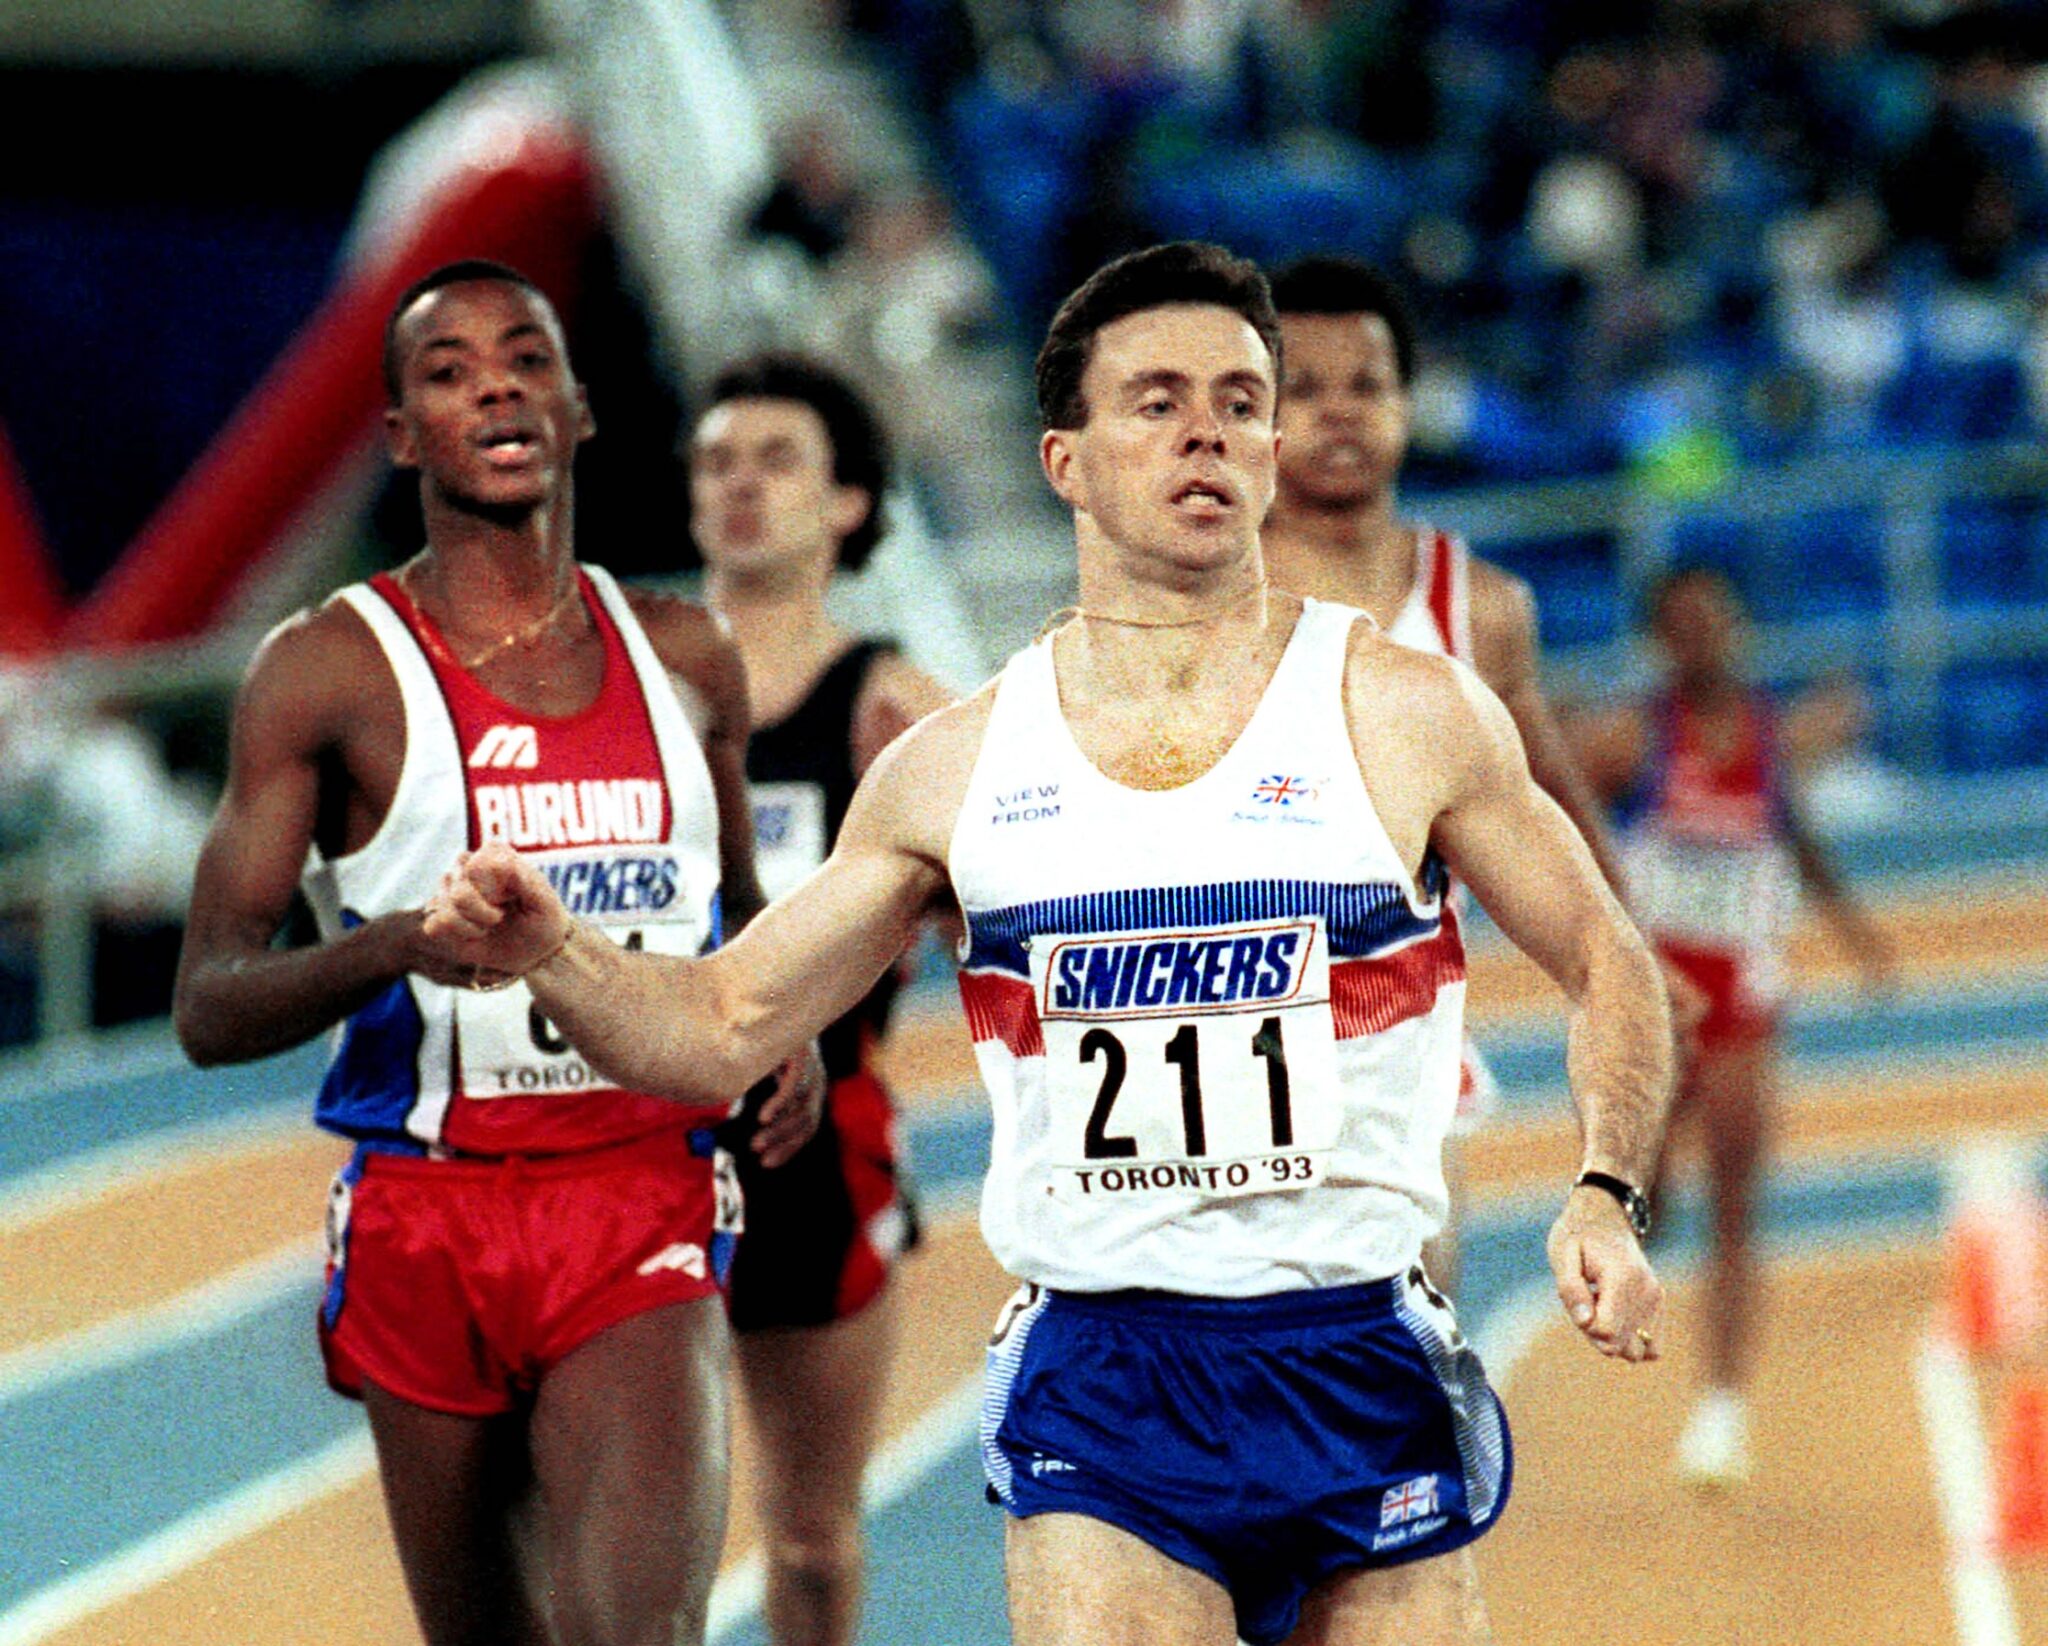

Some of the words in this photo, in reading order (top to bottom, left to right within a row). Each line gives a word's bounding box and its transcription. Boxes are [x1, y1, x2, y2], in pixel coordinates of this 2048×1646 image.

[474, 778, 664, 848] BURUNDI
[991, 805, 1061, 825] FROM
[995, 783, 1060, 807] VIEW
[547, 857, 678, 914] CKERS
[1054, 931, 1300, 1011] SNICKERS
[493, 1062, 595, 1090] TORO
[1078, 1015, 1294, 1160] 211
[1074, 1162, 1250, 1194] TORONTO
[1260, 1155, 1314, 1183] '93
